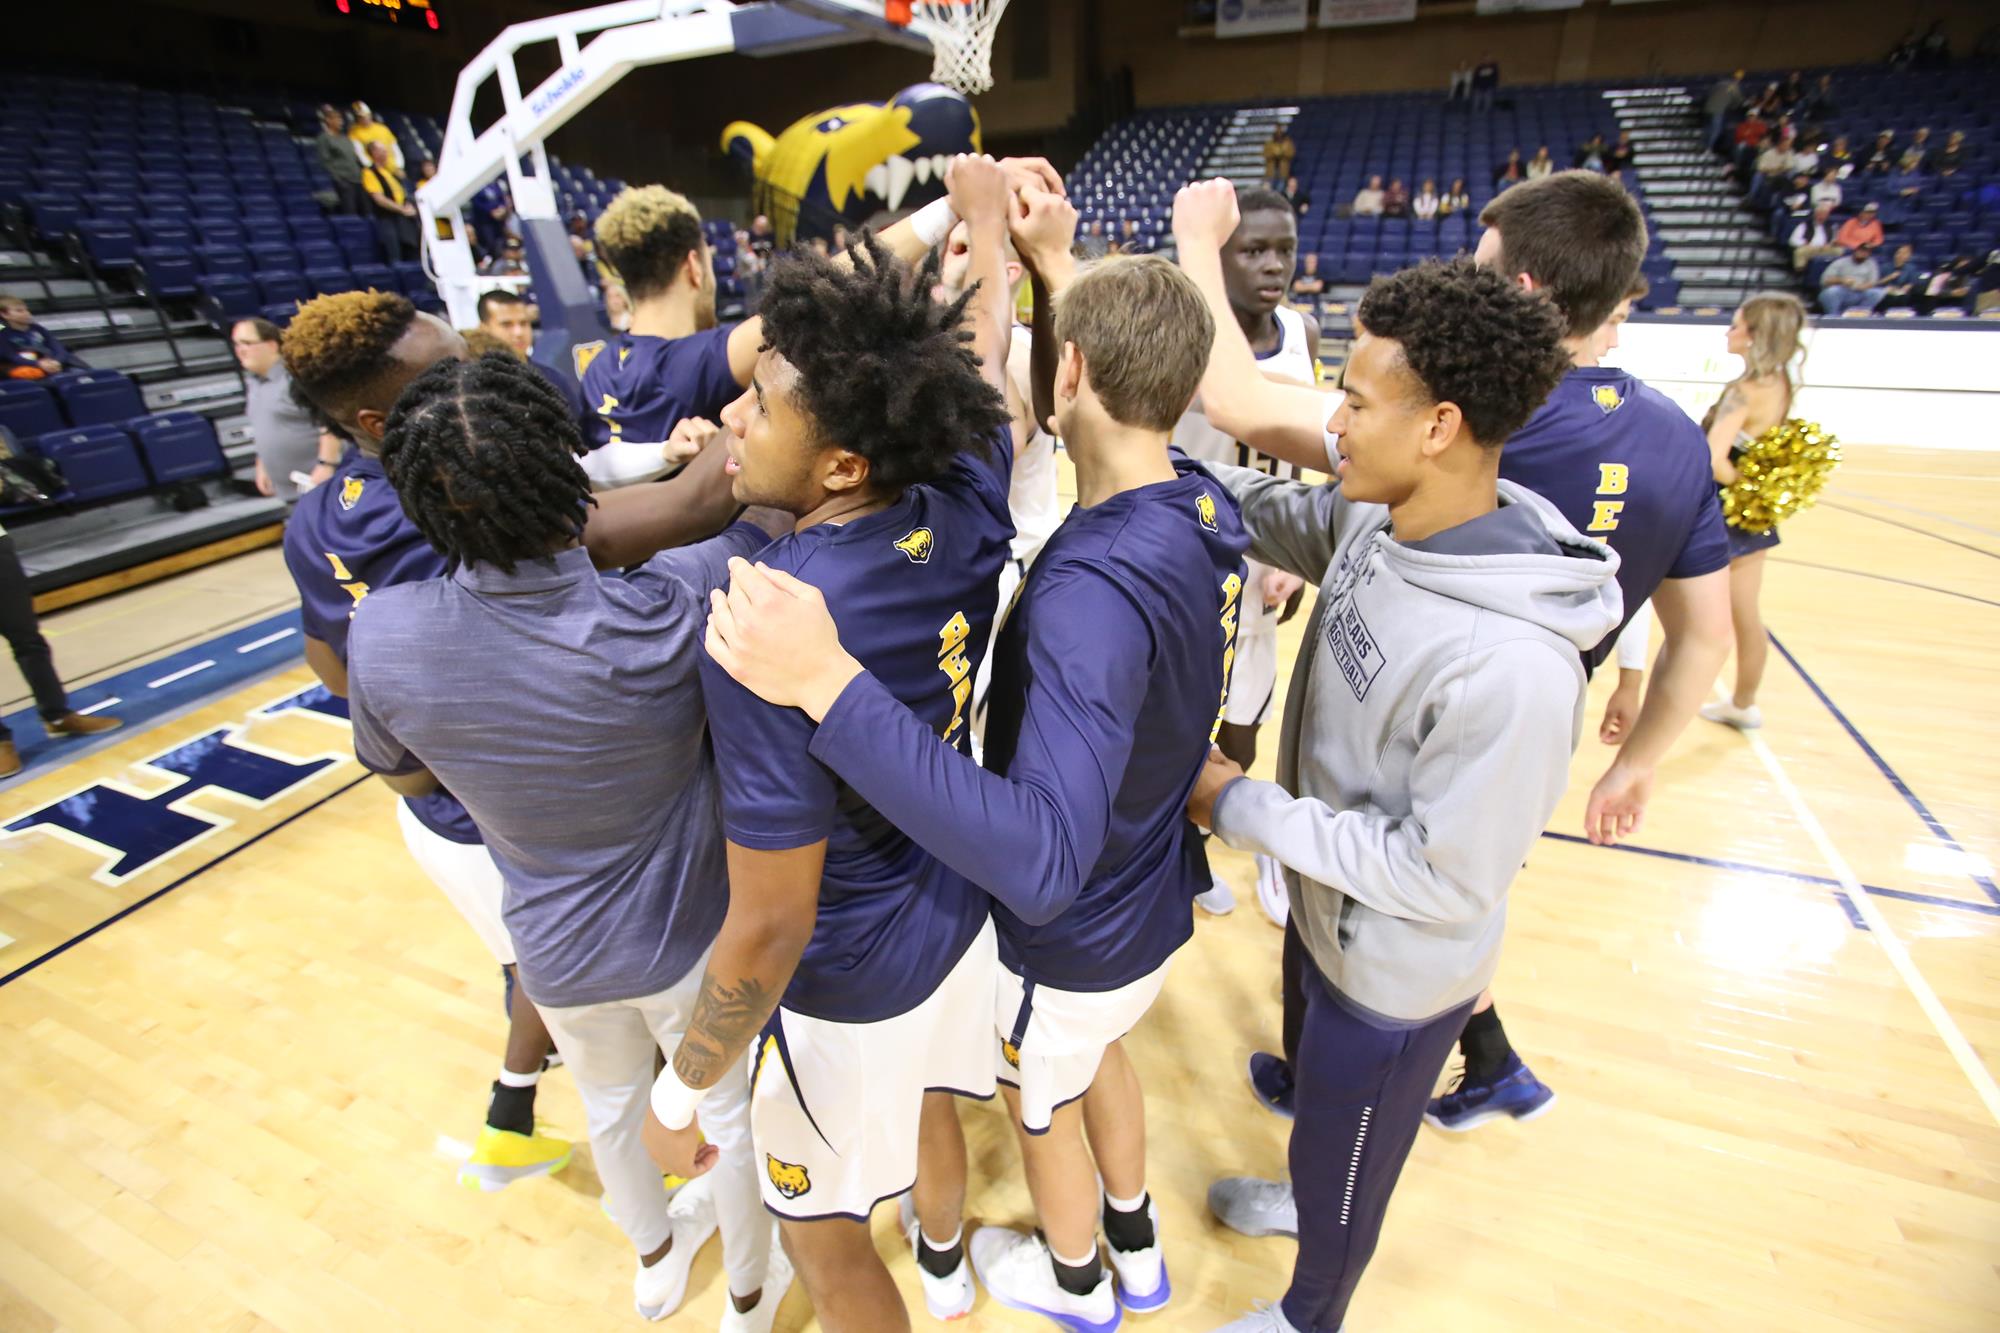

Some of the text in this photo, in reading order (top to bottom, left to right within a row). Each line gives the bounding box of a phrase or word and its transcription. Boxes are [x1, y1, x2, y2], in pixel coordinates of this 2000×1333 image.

[1586, 462, 1629, 545] BE
[1328, 622, 1362, 695] ASKETBALL
[1345, 607, 1372, 660] BEARS
